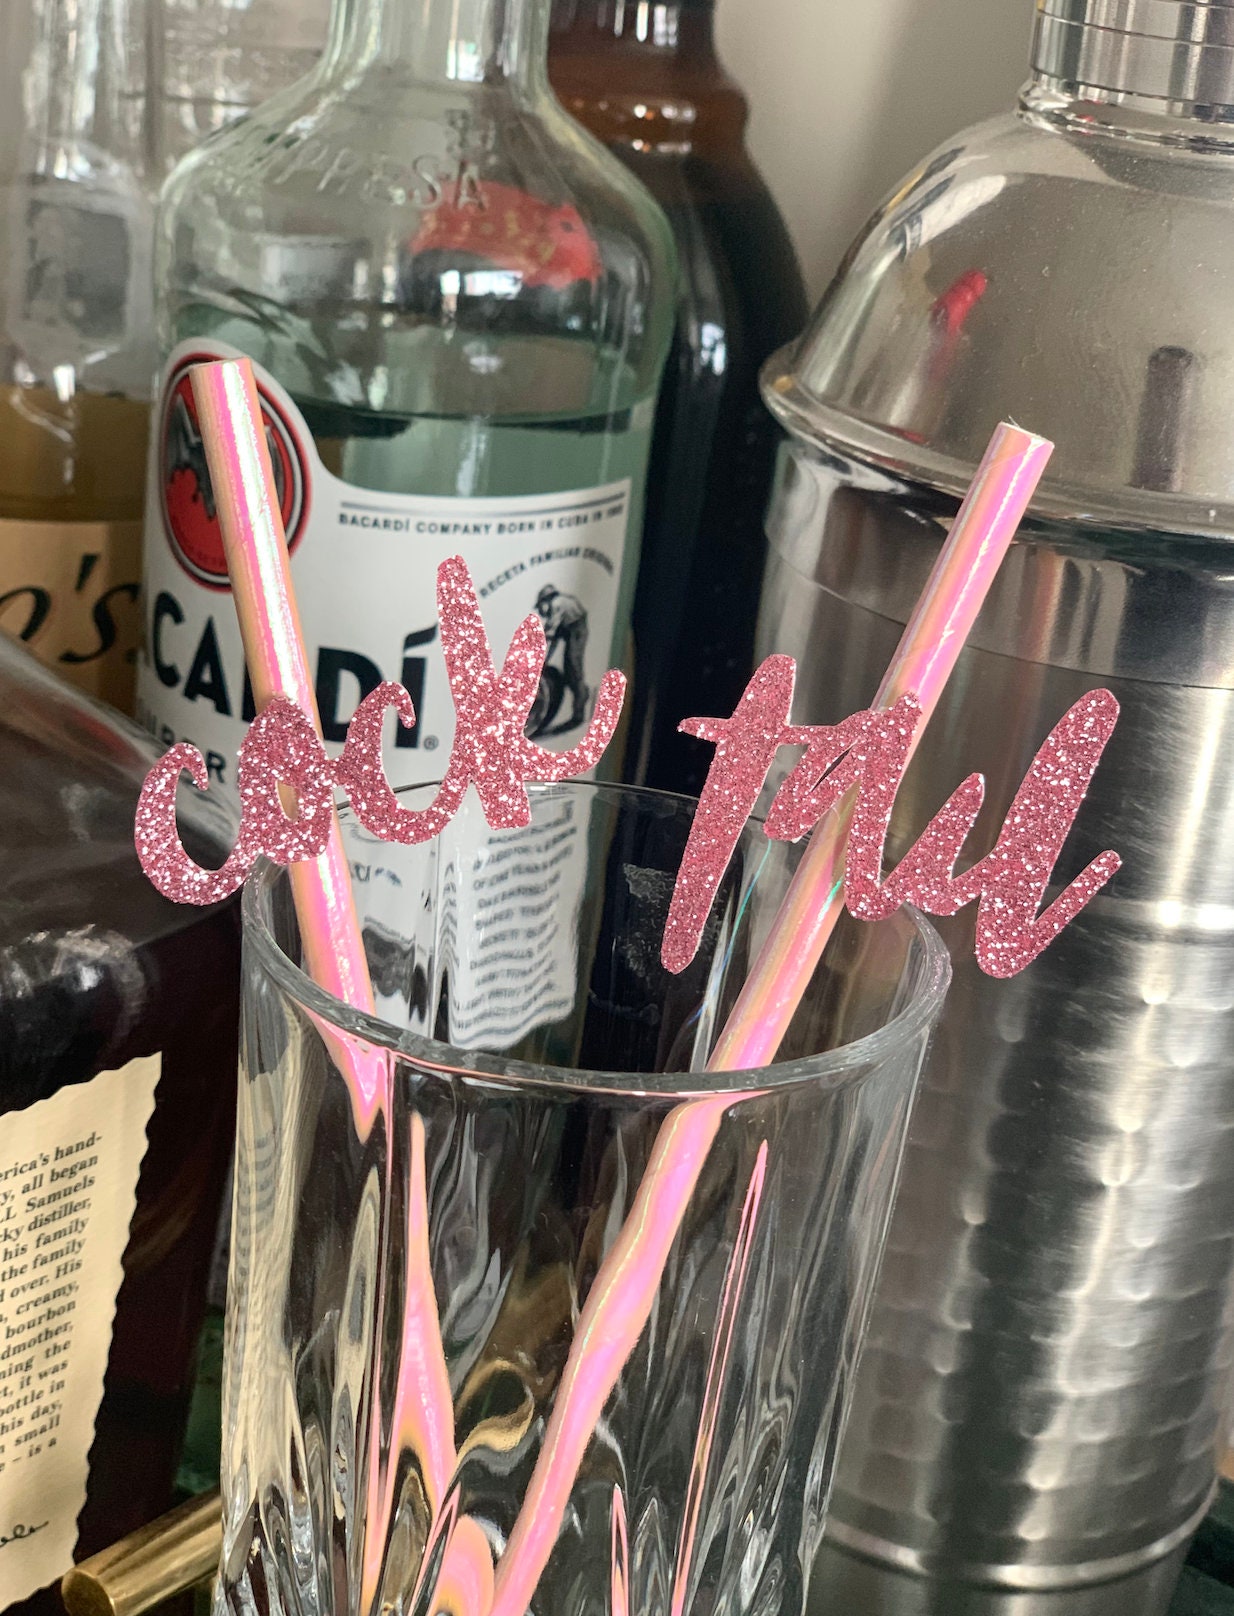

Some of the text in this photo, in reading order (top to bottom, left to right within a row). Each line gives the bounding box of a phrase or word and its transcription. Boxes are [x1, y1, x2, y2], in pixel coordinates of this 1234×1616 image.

[339, 513, 410, 532] BACARDÍ
[416, 521, 492, 535] COMPANY
[497, 521, 536, 534] BORN
[541, 519, 553, 531] IN
[558, 512, 589, 529] CUBA
[479, 562, 527, 598] RECETA
[134, 554, 628, 907] cock
[54, 1131, 103, 1161] hand-
[21, 1173, 44, 1194] all
[50, 1155, 98, 1183] began
[25, 1175, 95, 1213] Samuels
[28, 1197, 92, 1232] distiller,
[3, 1217, 89, 1262] his family
[1, 1239, 86, 1282] the family
[10, 1275, 49, 1298] over.
[55, 1258, 82, 1279] His
[16, 1281, 79, 1315] creamy,
[5, 1300, 76, 1339] bourbon
[44, 1340, 71, 1359] the
[19, 1375, 31, 1390] it
[38, 1360, 68, 1380] was
[49, 1380, 65, 1394] in
[31, 1400, 62, 1420] day,
[15, 1414, 60, 1446] small
[28, 1444, 42, 1458] is
[48, 1437, 57, 1448] a
